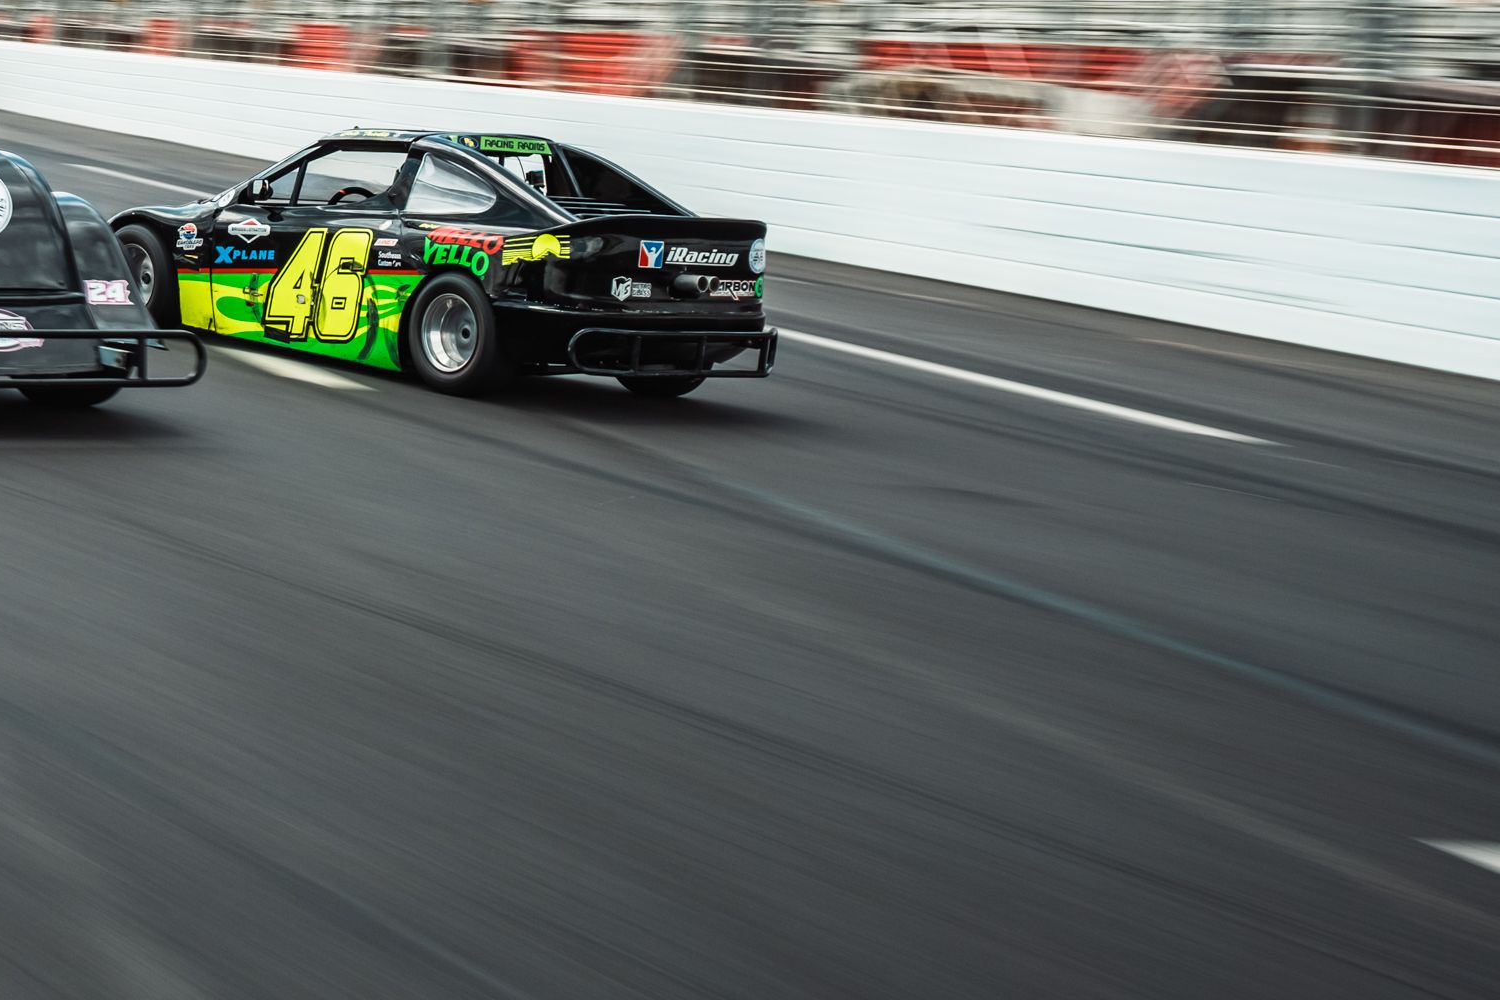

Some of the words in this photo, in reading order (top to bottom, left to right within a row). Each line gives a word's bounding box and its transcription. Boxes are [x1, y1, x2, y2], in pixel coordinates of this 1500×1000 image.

[485, 138, 514, 150] RACING
[427, 226, 504, 256] MELLO
[423, 236, 490, 277] YELLO
[665, 246, 740, 267] iRacing
[264, 227, 374, 342] 46
